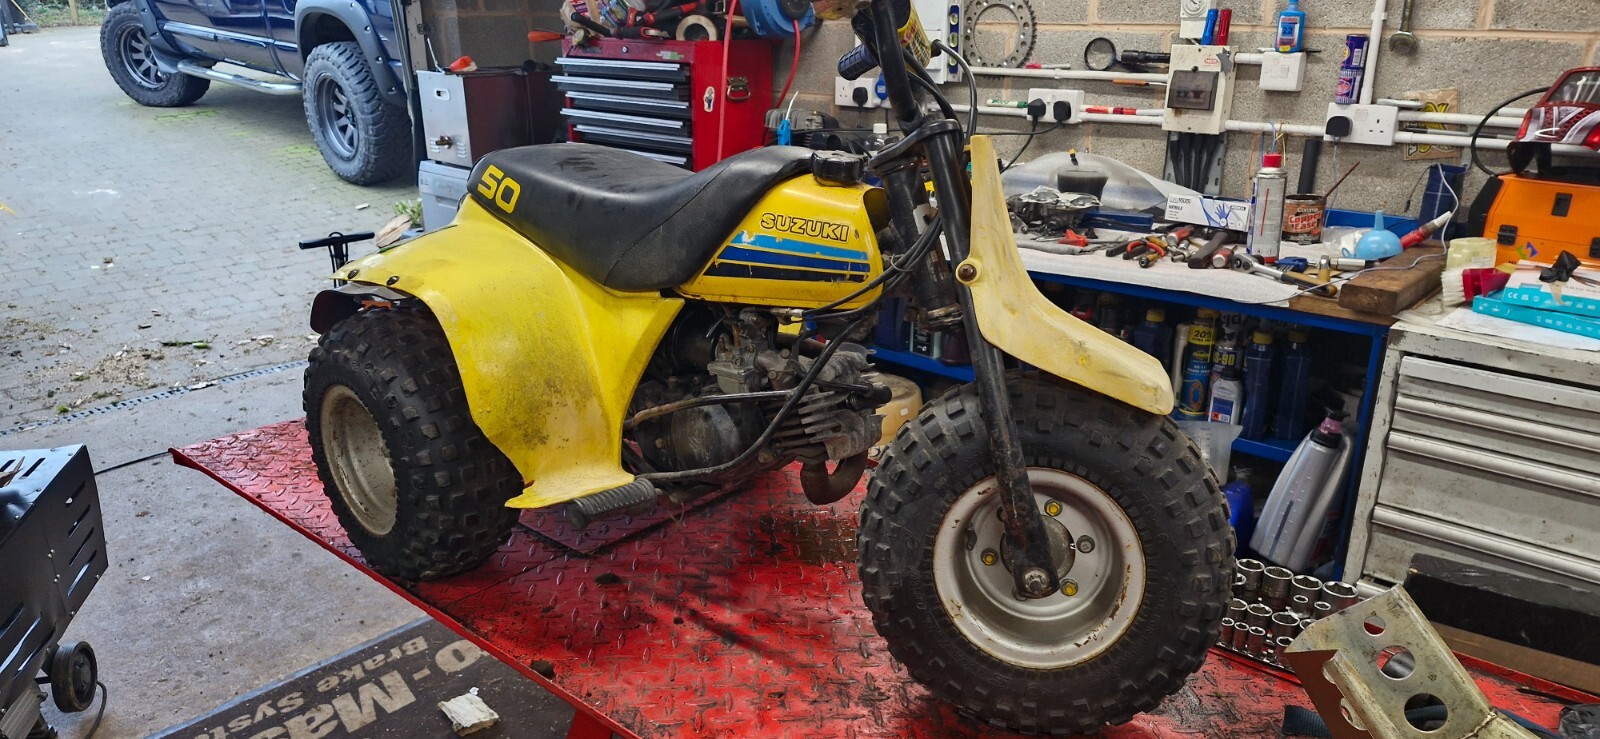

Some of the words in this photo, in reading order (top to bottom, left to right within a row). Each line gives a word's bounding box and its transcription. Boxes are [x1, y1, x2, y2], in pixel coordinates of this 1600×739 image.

[477, 164, 521, 214] 50
[760, 212, 850, 242] SUZUKI
[1288, 211, 1322, 225] Copper
[1294, 220, 1318, 232] Ease
[316, 635, 428, 692] Brake
